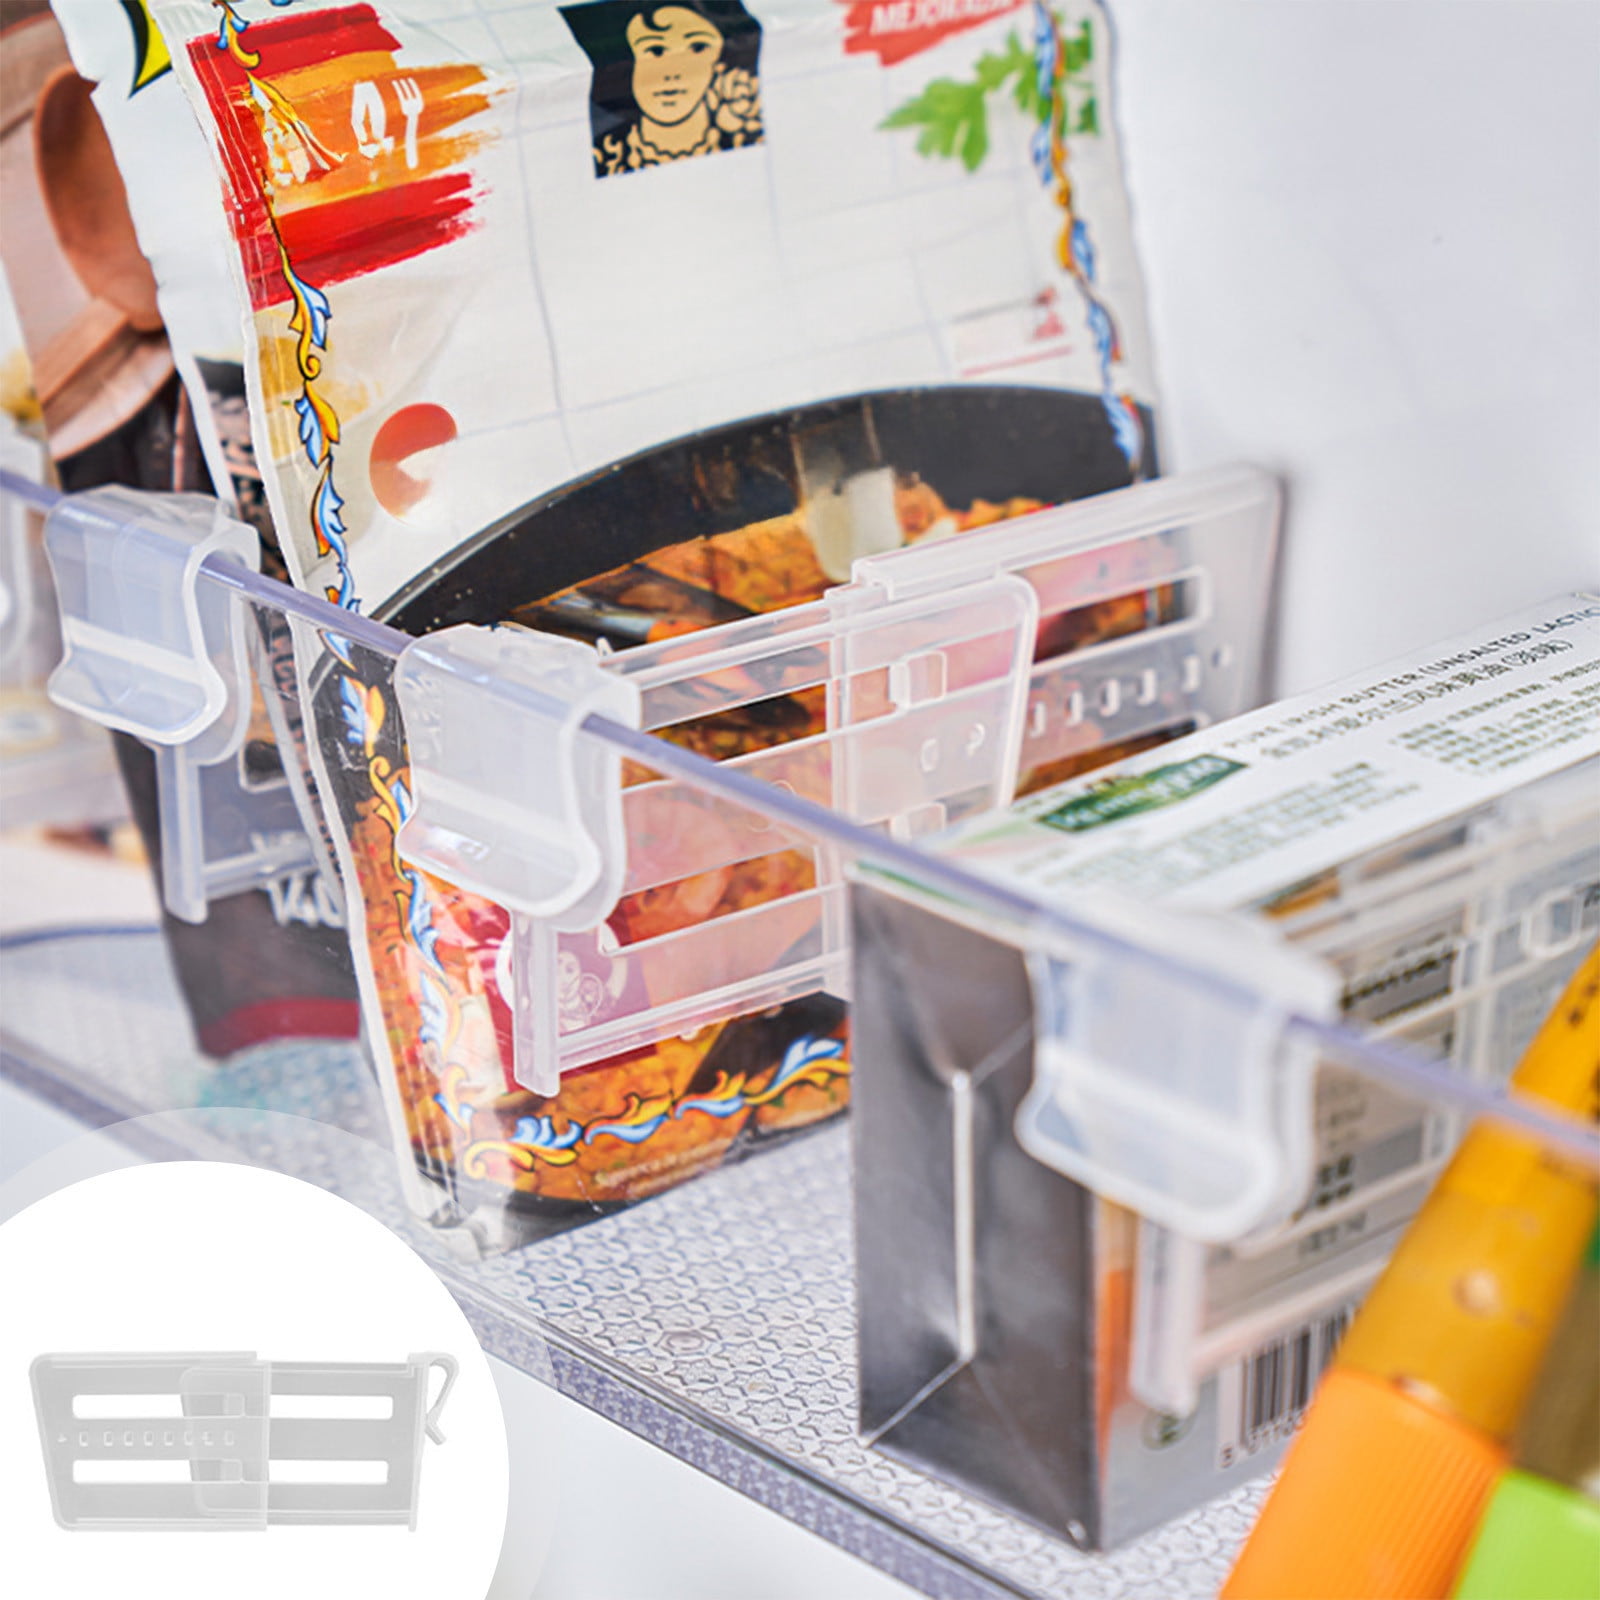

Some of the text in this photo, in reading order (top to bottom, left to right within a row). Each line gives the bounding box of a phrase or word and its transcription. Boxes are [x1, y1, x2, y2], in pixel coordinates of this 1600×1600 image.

[1280, 702, 1344, 728] IRISH
[1339, 673, 1425, 703] BUTTER
[1417, 631, 1531, 677] (UNSALTED
